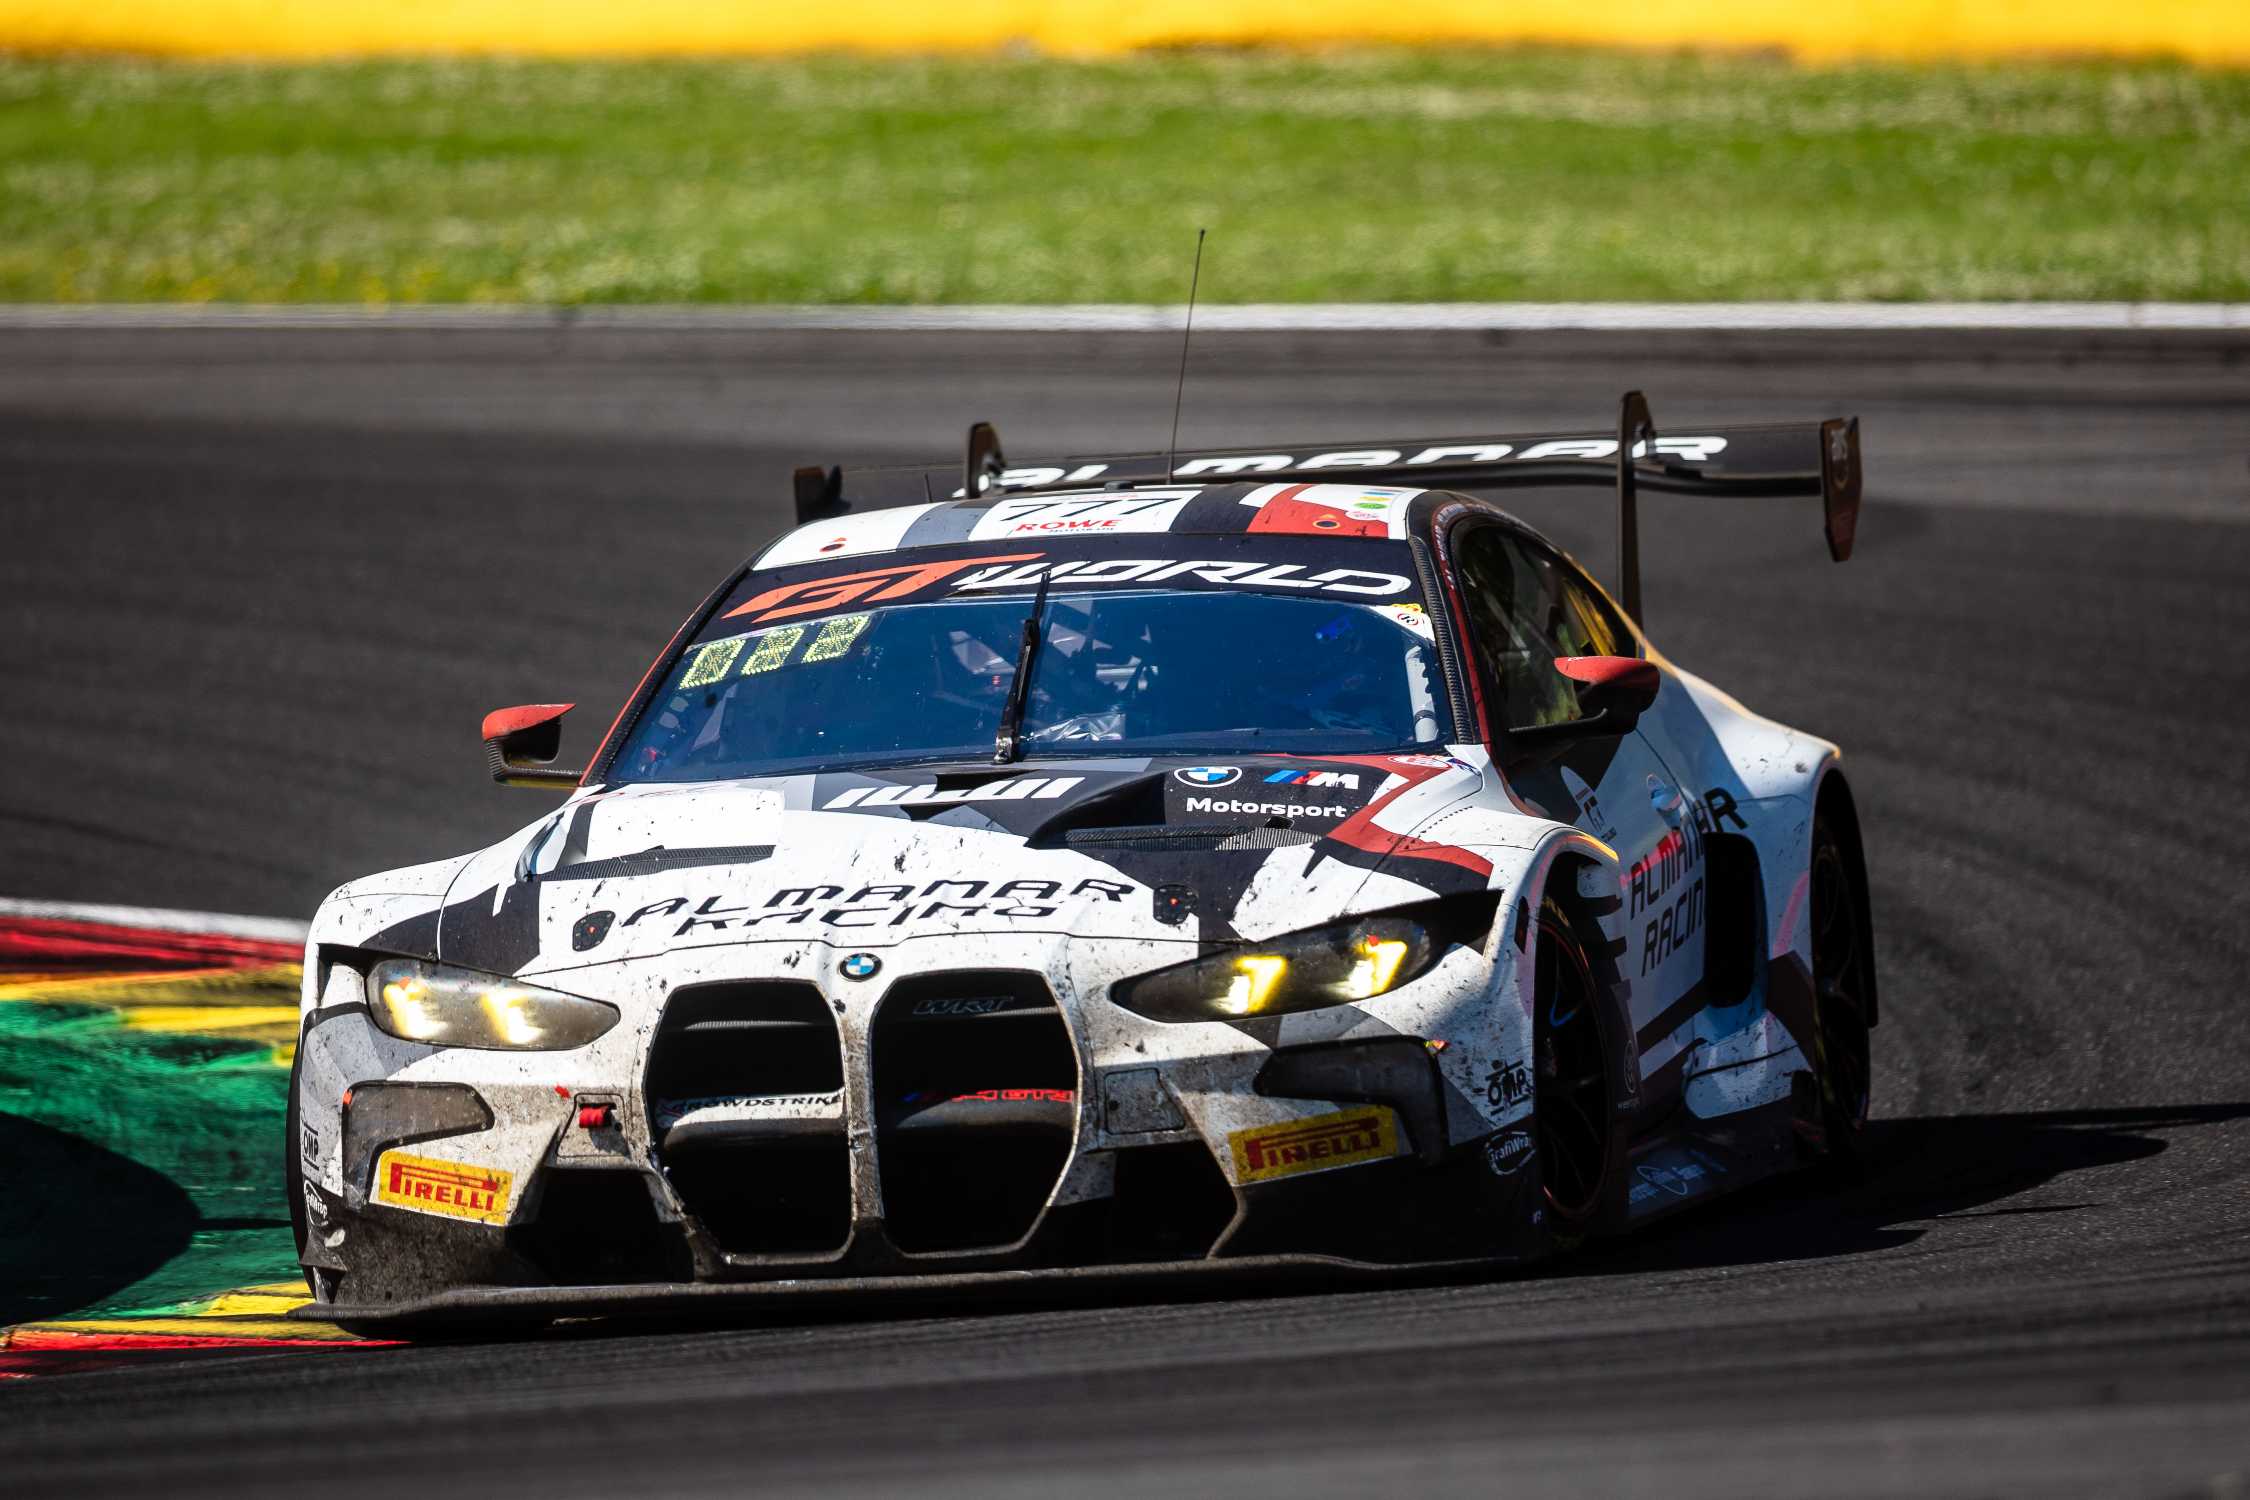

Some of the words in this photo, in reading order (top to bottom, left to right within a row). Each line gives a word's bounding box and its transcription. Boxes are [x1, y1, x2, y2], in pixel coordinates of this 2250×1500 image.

[1001, 498, 1181, 521] 777
[1015, 519, 1122, 532] ROWE
[1186, 797, 1347, 818] Motorsport
[621, 878, 1136, 927] ALMANAR
[1641, 877, 1704, 977] RACIN
[684, 1093, 842, 1112] ROWDSTRIKE
[1488, 1068, 1528, 1106] OMP
[303, 1130, 319, 1162] OMP
[1244, 1116, 1381, 1172] PIRELLI
[389, 1162, 499, 1211] PIRELLI
